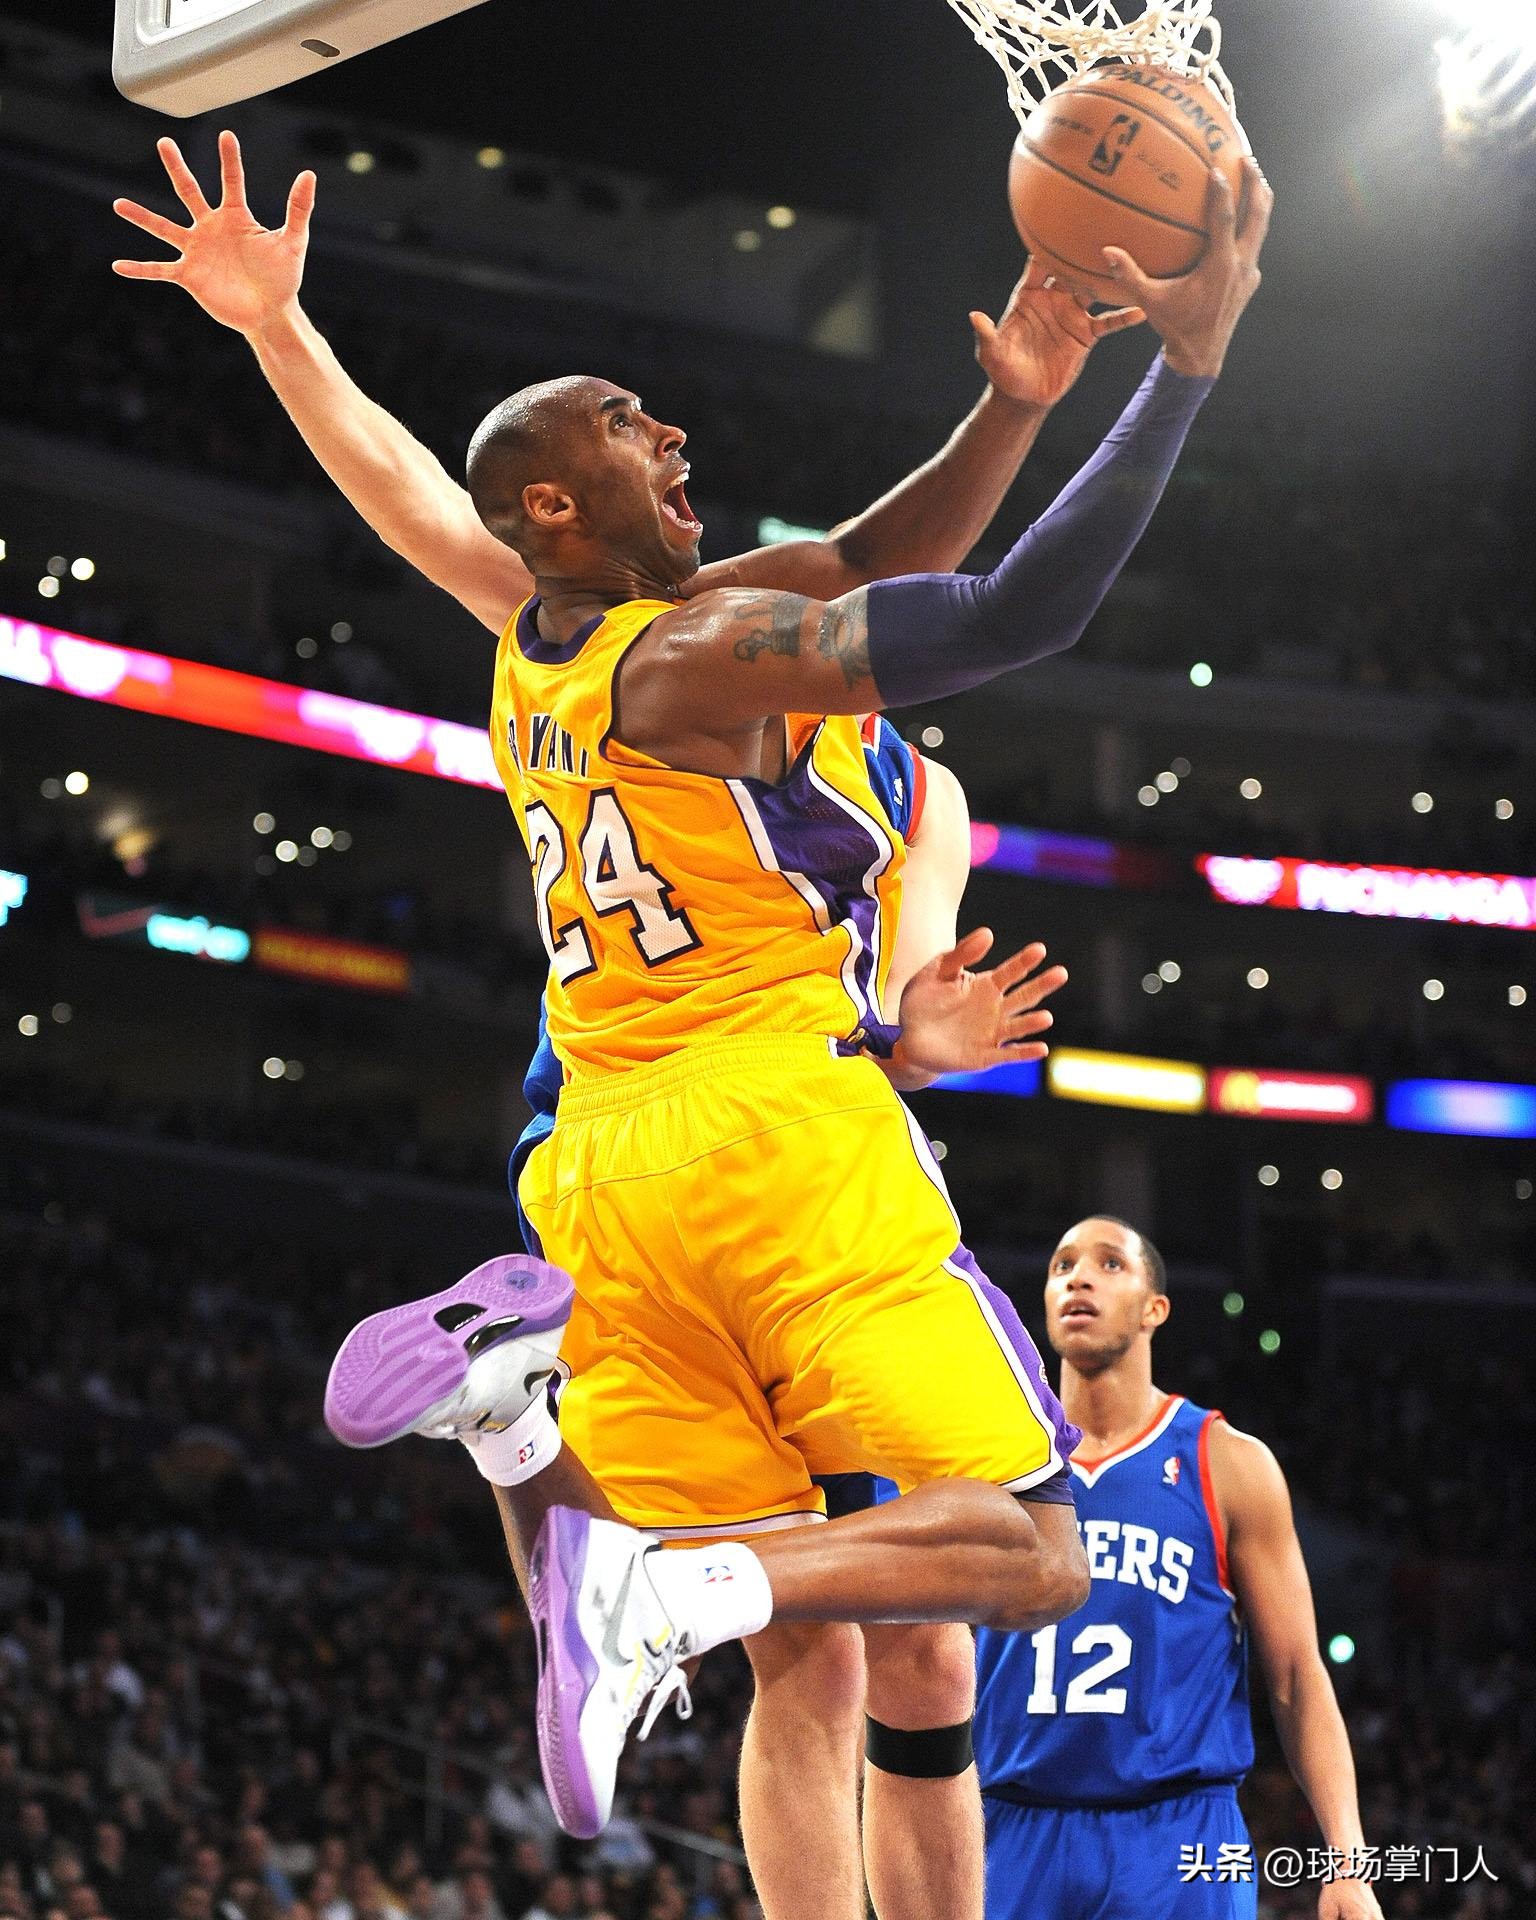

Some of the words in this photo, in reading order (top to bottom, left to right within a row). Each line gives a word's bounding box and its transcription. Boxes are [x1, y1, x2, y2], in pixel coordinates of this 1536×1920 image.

[1096, 64, 1229, 152] PALDING
[525, 785, 705, 989] 24
[1077, 1520, 1194, 1605] ERS
[1027, 1624, 1133, 1714] 12
